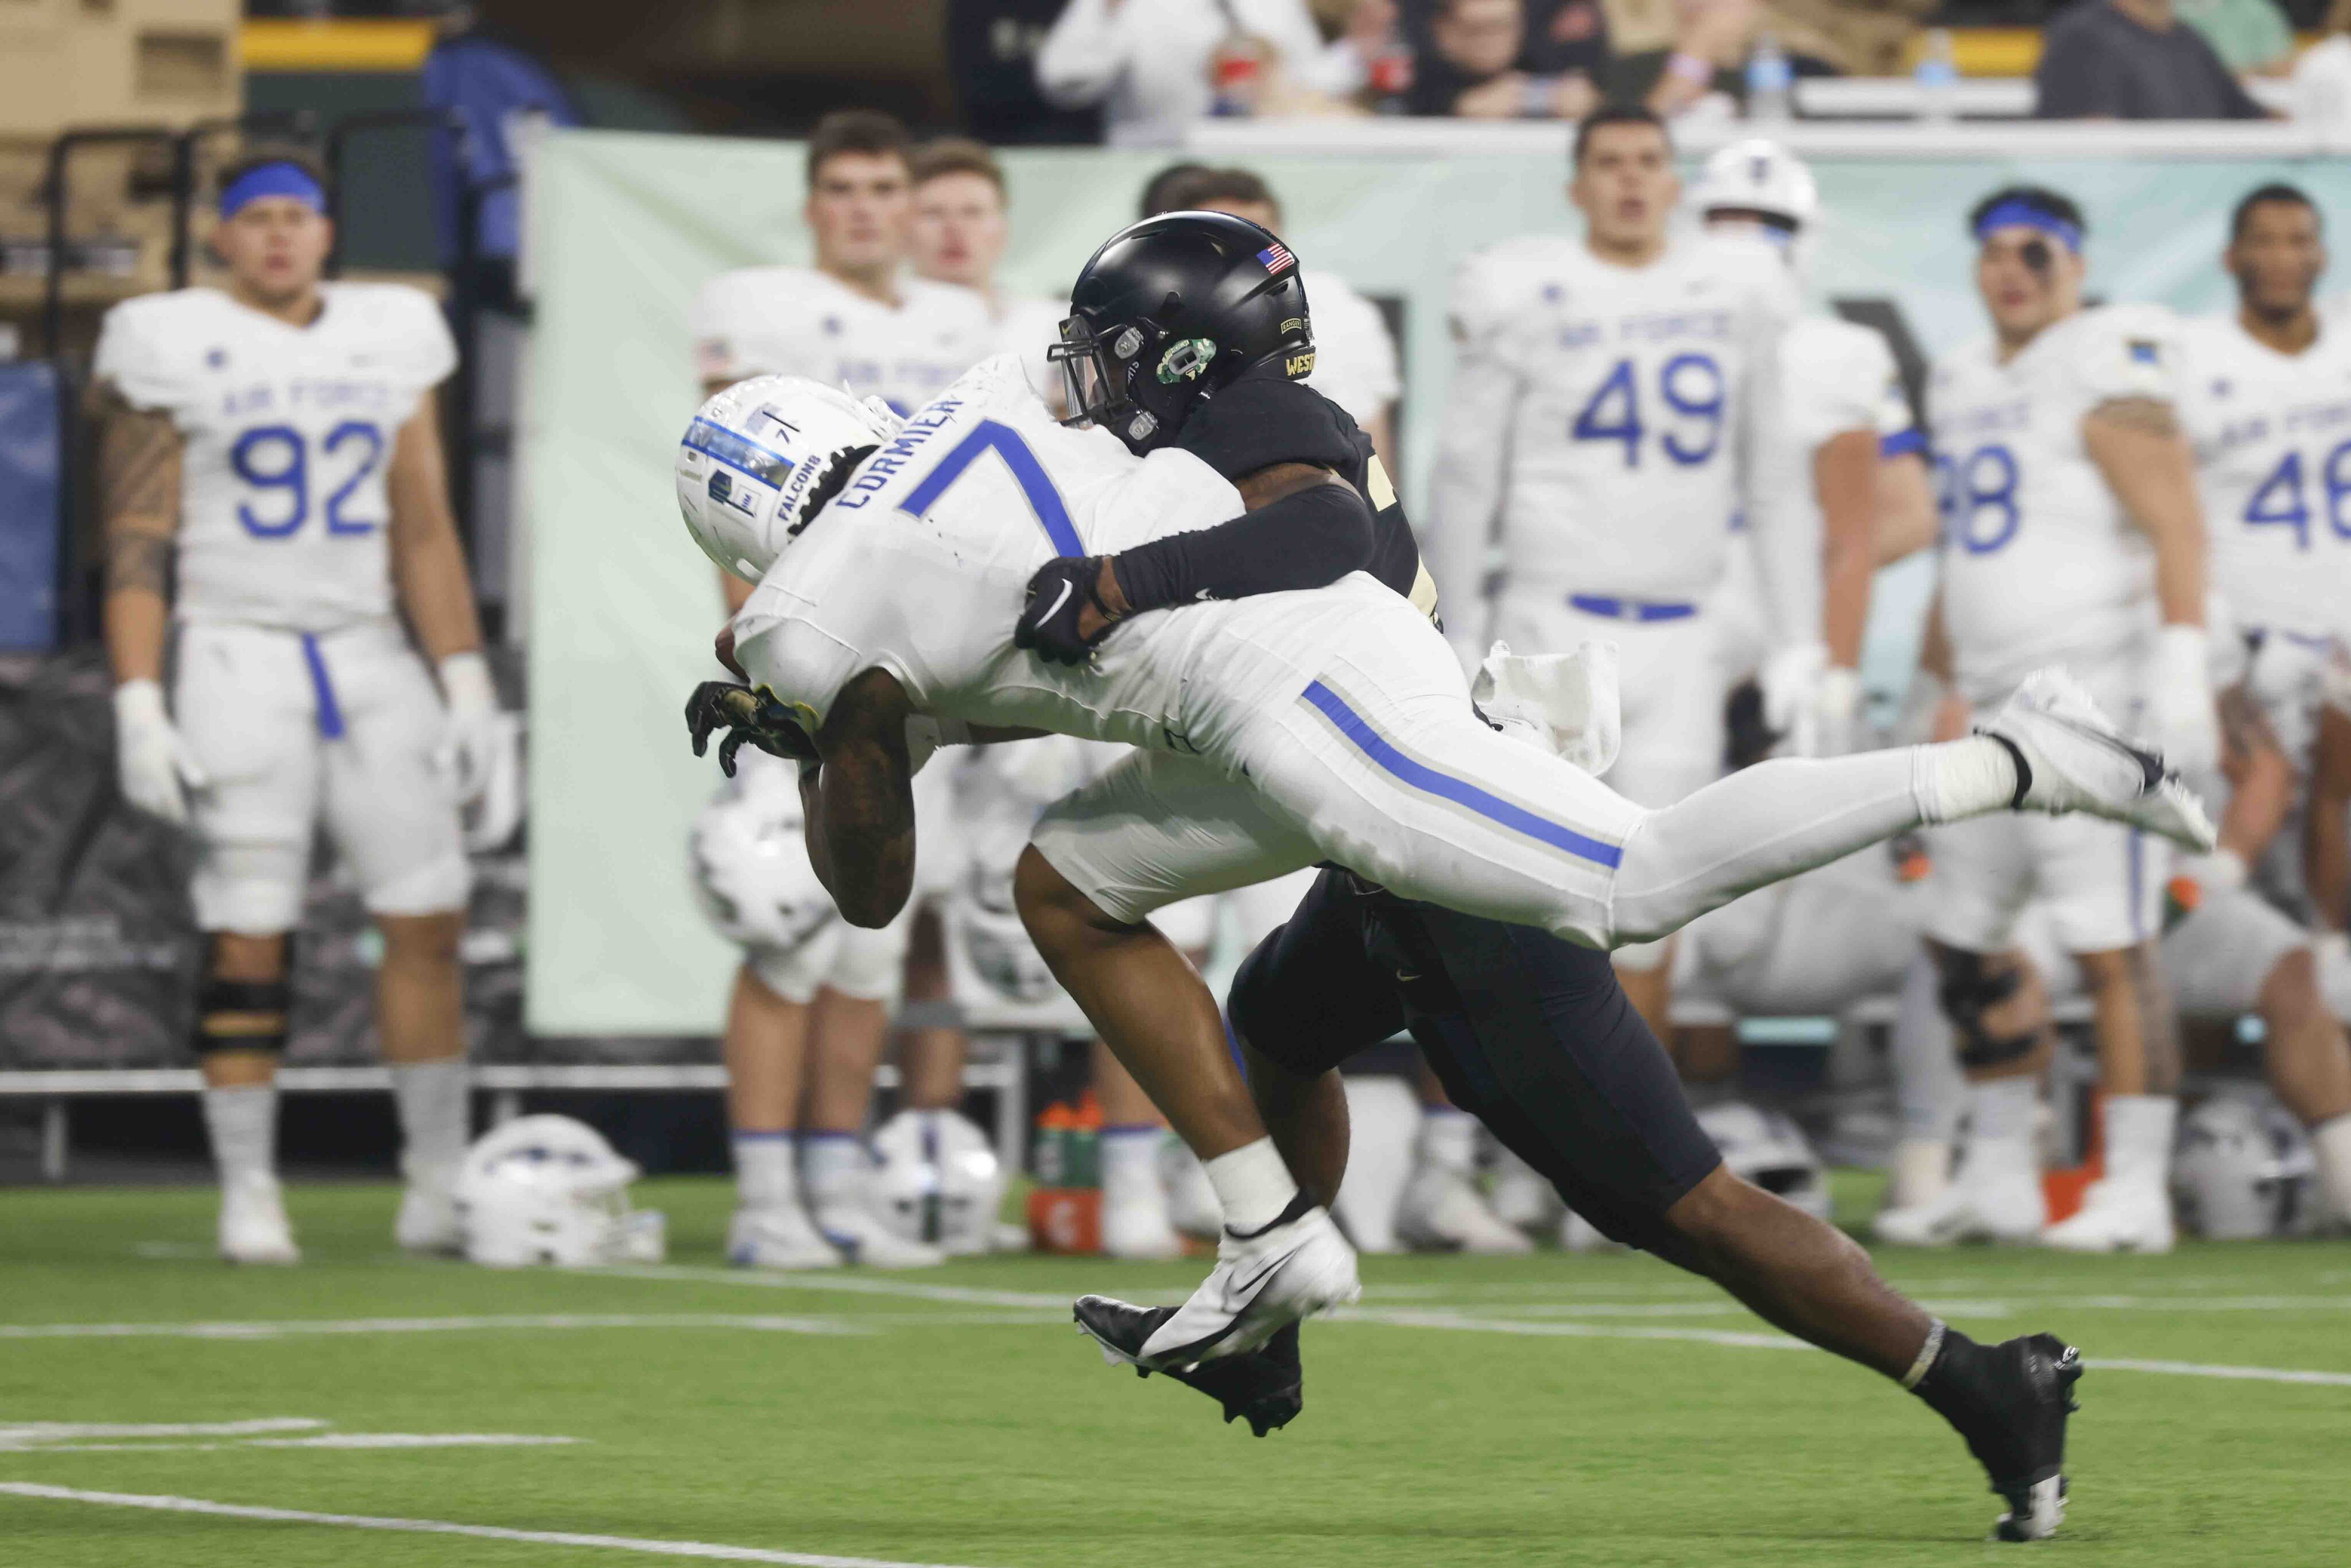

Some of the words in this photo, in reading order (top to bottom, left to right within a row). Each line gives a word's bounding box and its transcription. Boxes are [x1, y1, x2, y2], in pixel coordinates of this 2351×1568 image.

[1282, 320, 1301, 331] RANGER
[1286, 352, 1316, 376] WEST
[836, 400, 963, 509] CORMIER
[1571, 351, 1729, 468] 49
[230, 422, 383, 538] 92
[778, 455, 821, 521] FALCONS
[894, 416, 1087, 558] 7
